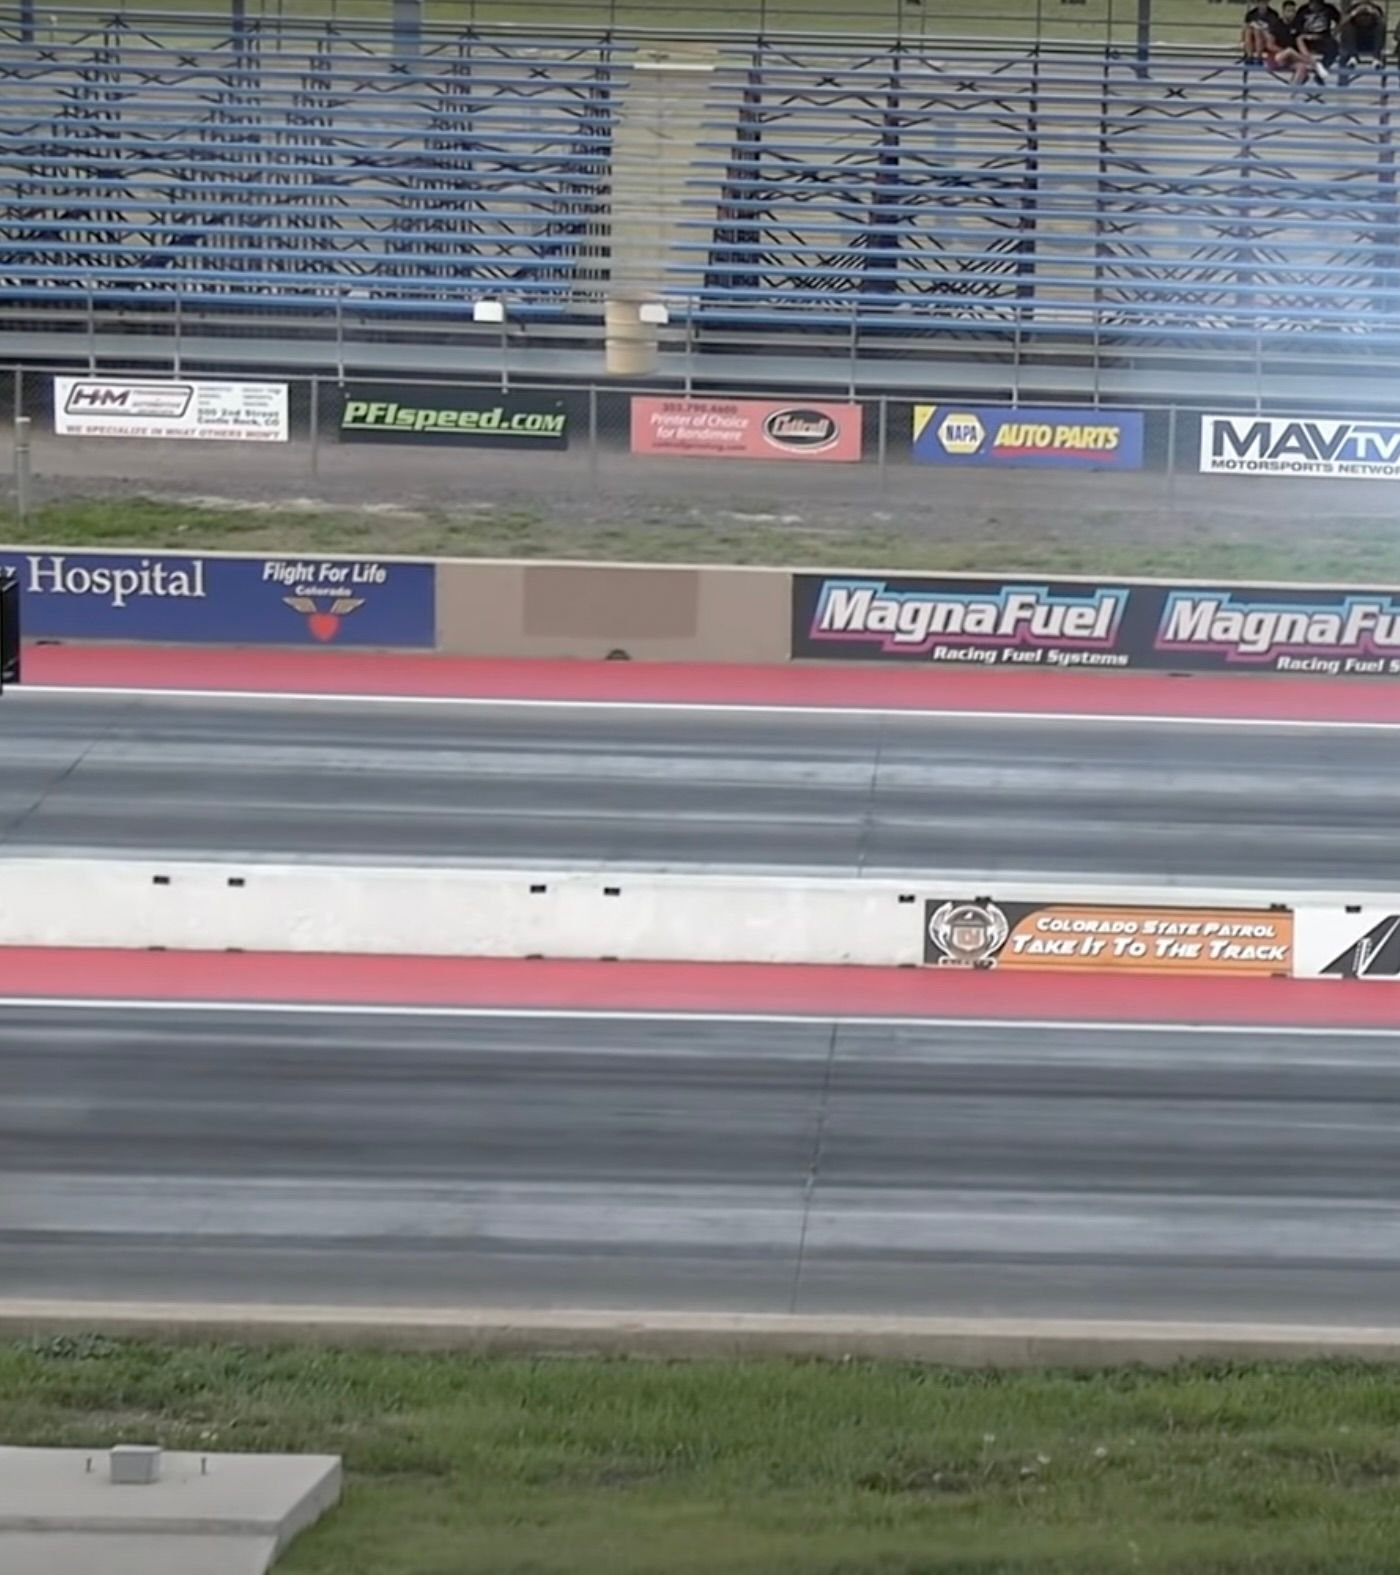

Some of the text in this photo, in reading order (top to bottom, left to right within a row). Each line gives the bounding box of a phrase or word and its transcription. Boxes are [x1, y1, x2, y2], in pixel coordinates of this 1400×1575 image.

[946, 424, 977, 442] NAPA
[993, 424, 1120, 449] AUTO PARTS
[1211, 459, 1334, 473] MOTORSPORTS
[26, 556, 206, 607] Hospital
[262, 561, 387, 585] Flight For Life
[295, 585, 353, 596] Colorado
[819, 589, 1118, 643] MagnaFuel
[933, 645, 1128, 666] Racing Fuel Systems
[1276, 656, 1340, 673] Racing
[1344, 658, 1384, 673] Fuel
